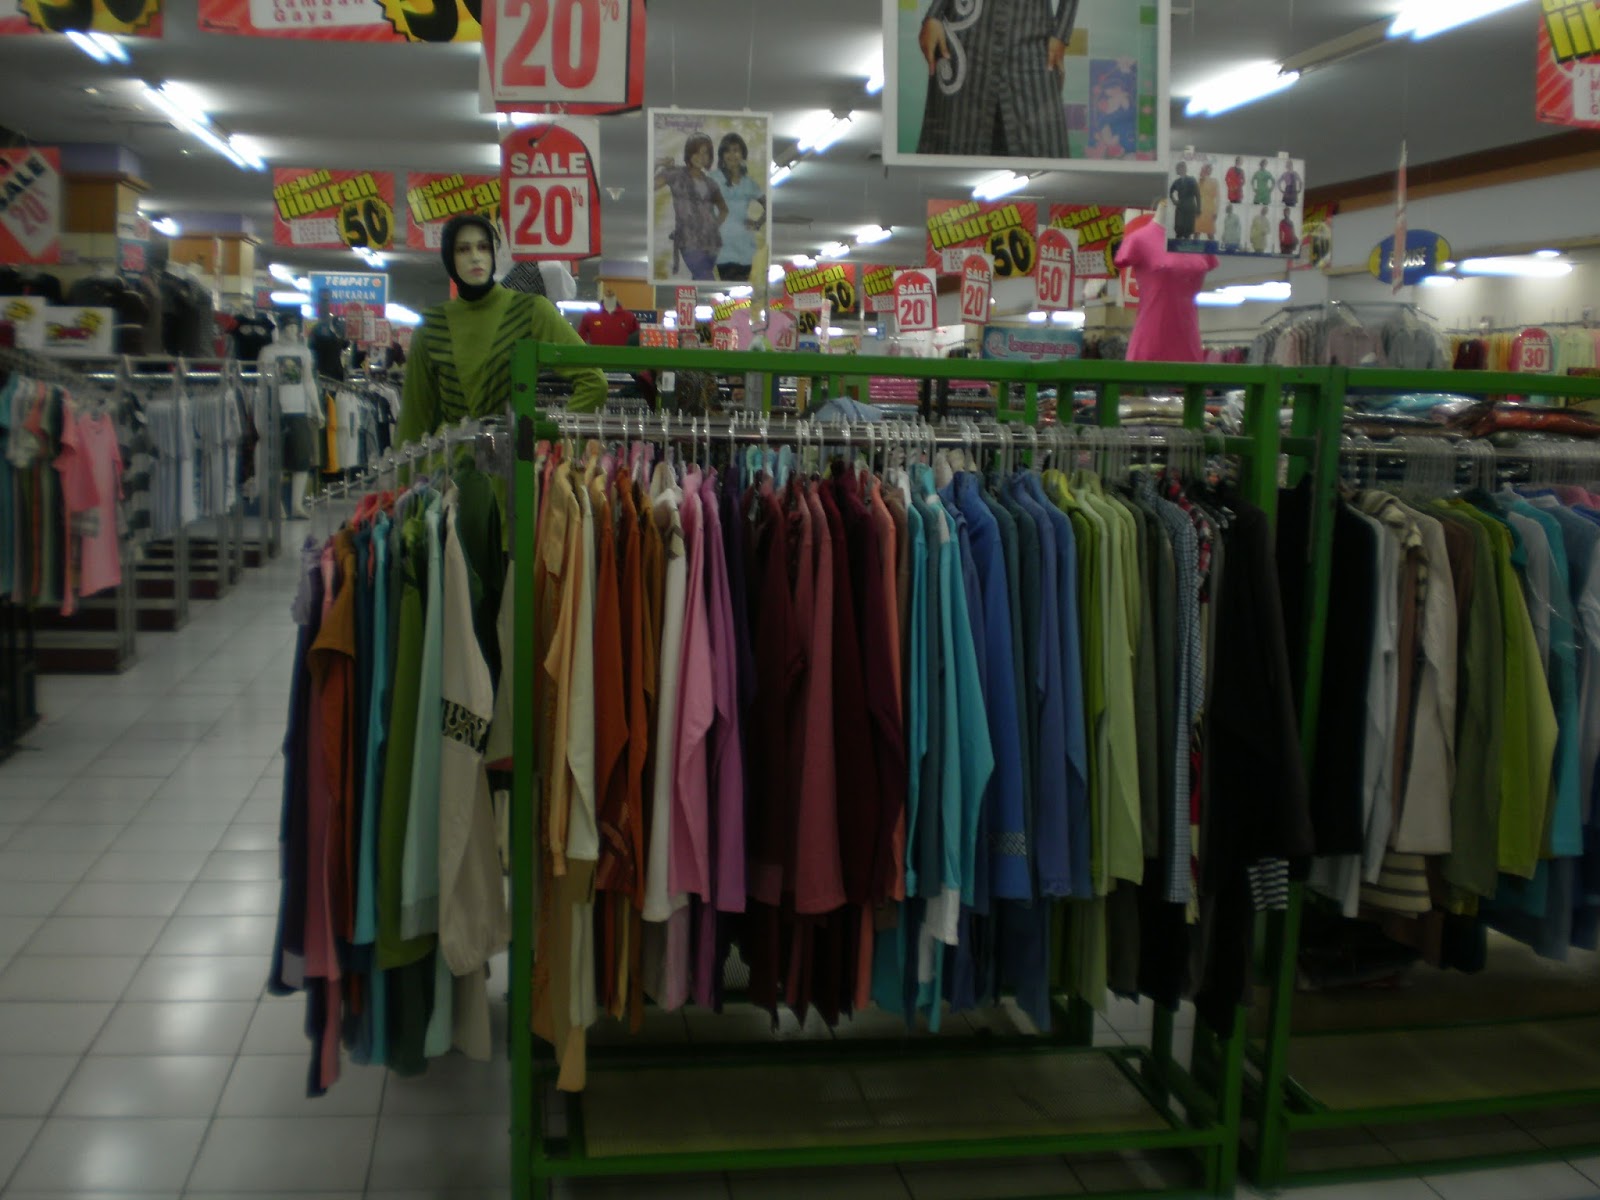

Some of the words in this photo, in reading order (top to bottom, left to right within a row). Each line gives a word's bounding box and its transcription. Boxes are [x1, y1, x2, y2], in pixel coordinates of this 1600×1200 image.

[274, 9, 333, 22] Gaya
[510, 152, 588, 175] SALE
[273, 168, 332, 200] diskon
[406, 173, 465, 203] diskon
[276, 171, 379, 220] liburan
[928, 200, 980, 231] diskon
[930, 203, 1023, 250] liburan
[1041, 246, 1072, 260] SALE
[325, 276, 370, 287] TEMPAT
[786, 264, 846, 296] liburan
[966, 267, 991, 283] SALE
[331, 290, 377, 300] NUKARAN
[678, 288, 696, 299] SALE
[899, 283, 932, 295] SALE
